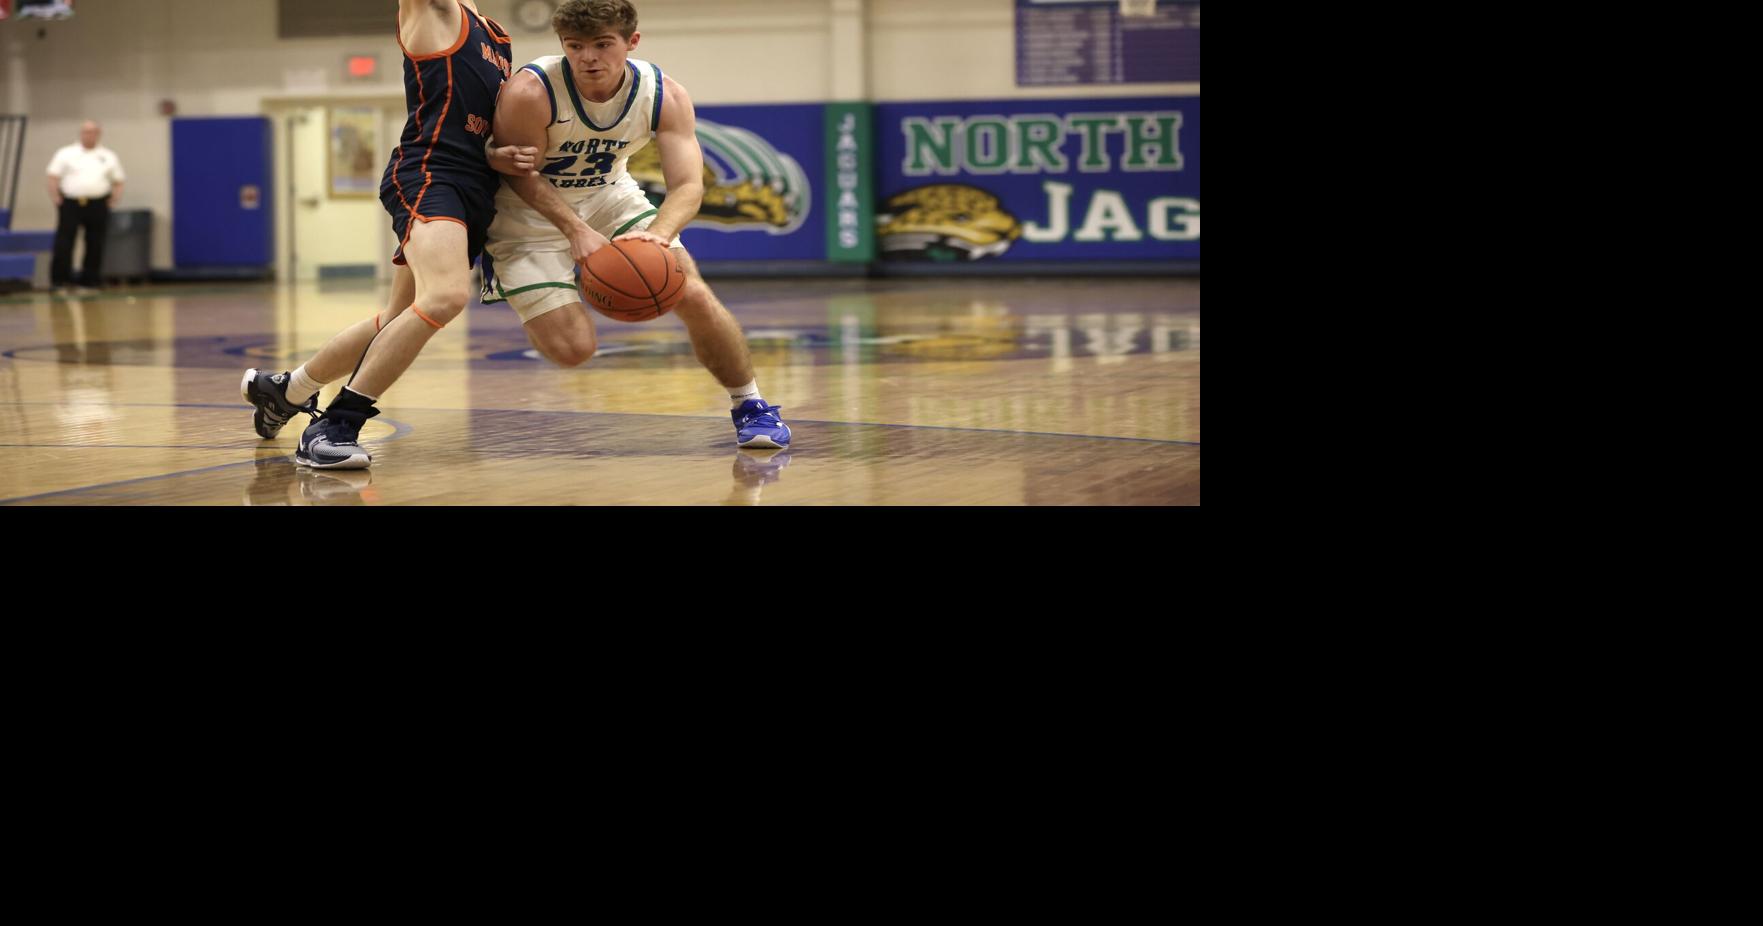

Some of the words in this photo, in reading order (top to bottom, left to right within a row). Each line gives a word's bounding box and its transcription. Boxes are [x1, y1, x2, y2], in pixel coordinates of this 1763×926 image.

[540, 152, 617, 176] 23
[902, 111, 1184, 176] NORTH
[837, 113, 858, 248] JAGUARS
[1022, 181, 1200, 243] JAG
